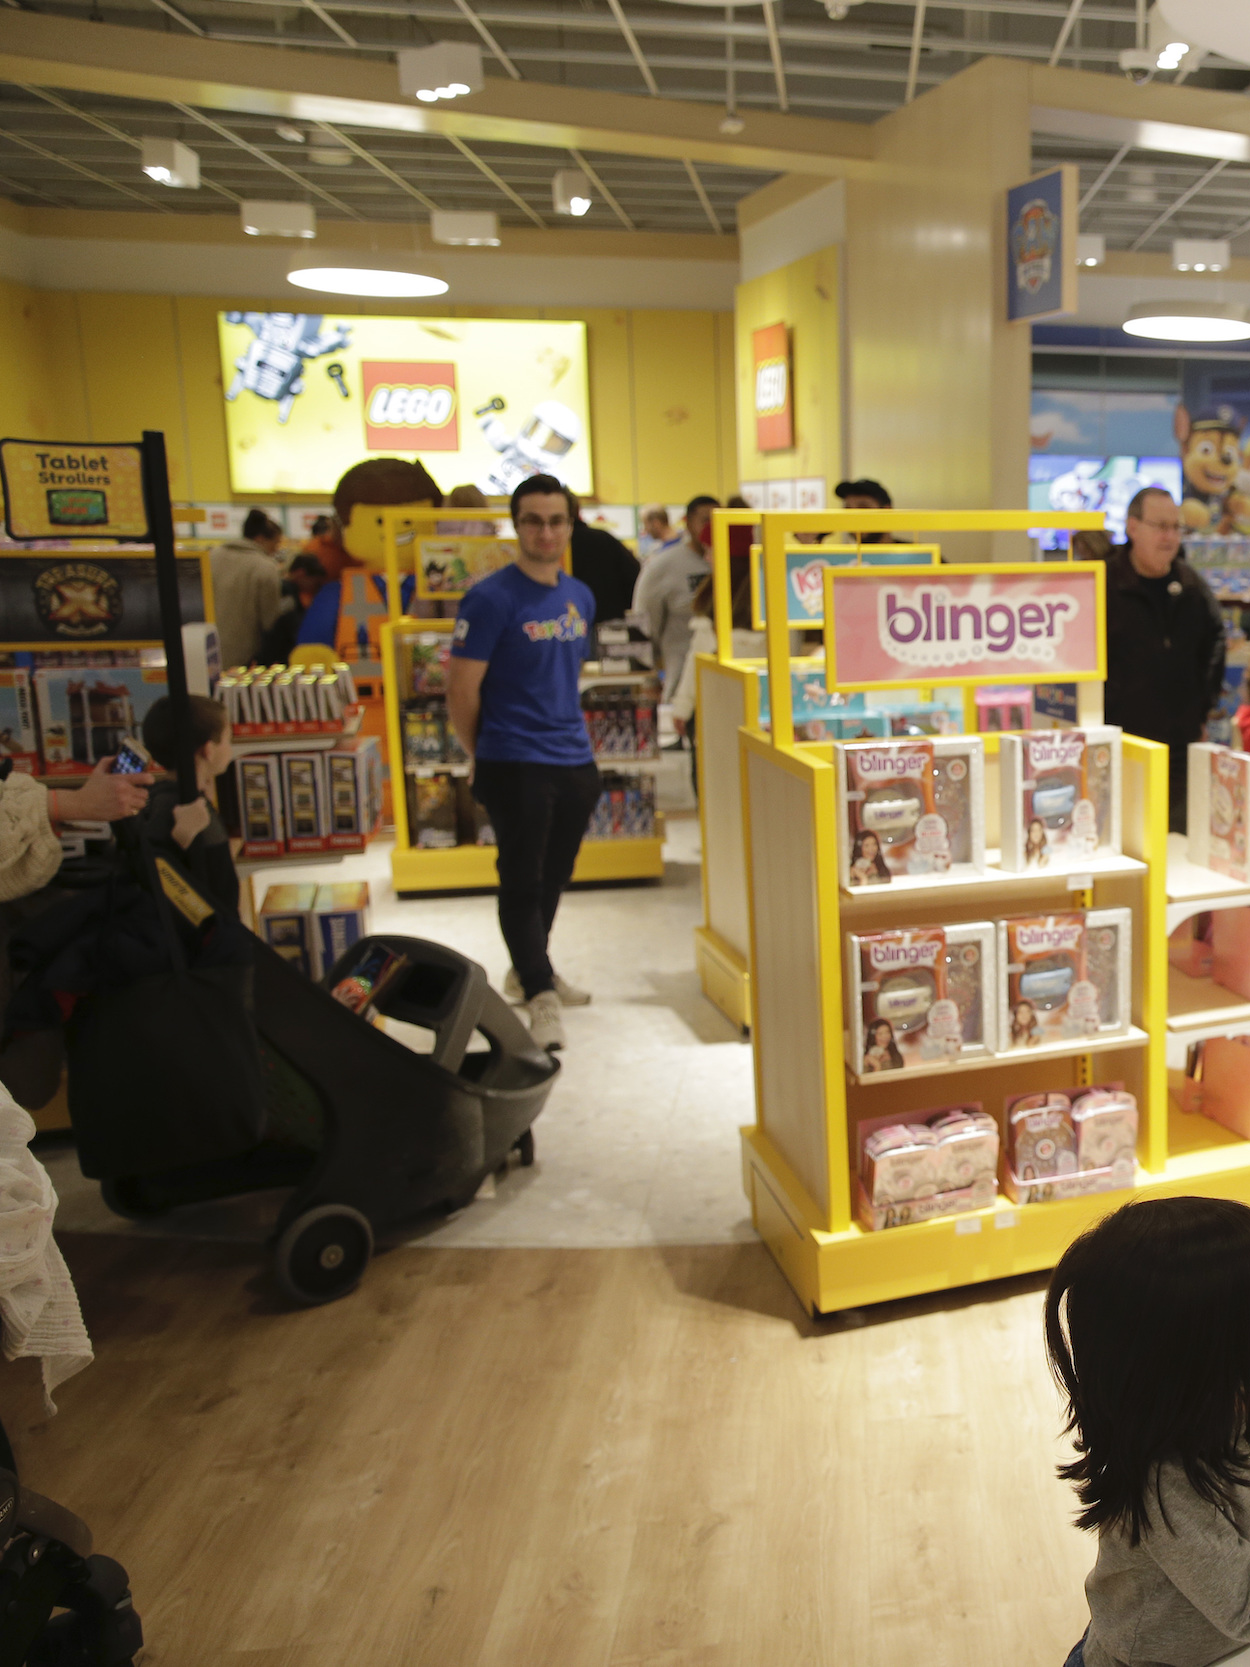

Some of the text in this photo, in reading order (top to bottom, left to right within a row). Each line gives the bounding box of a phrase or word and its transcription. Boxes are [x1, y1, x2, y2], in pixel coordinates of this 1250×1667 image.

[369, 387, 453, 425] LEGO
[36, 453, 108, 471] Tablet
[38, 472, 111, 485] Strollers
[886, 593, 1070, 653] blinger
[860, 754, 926, 774] blinger
[873, 943, 938, 962] blinger
